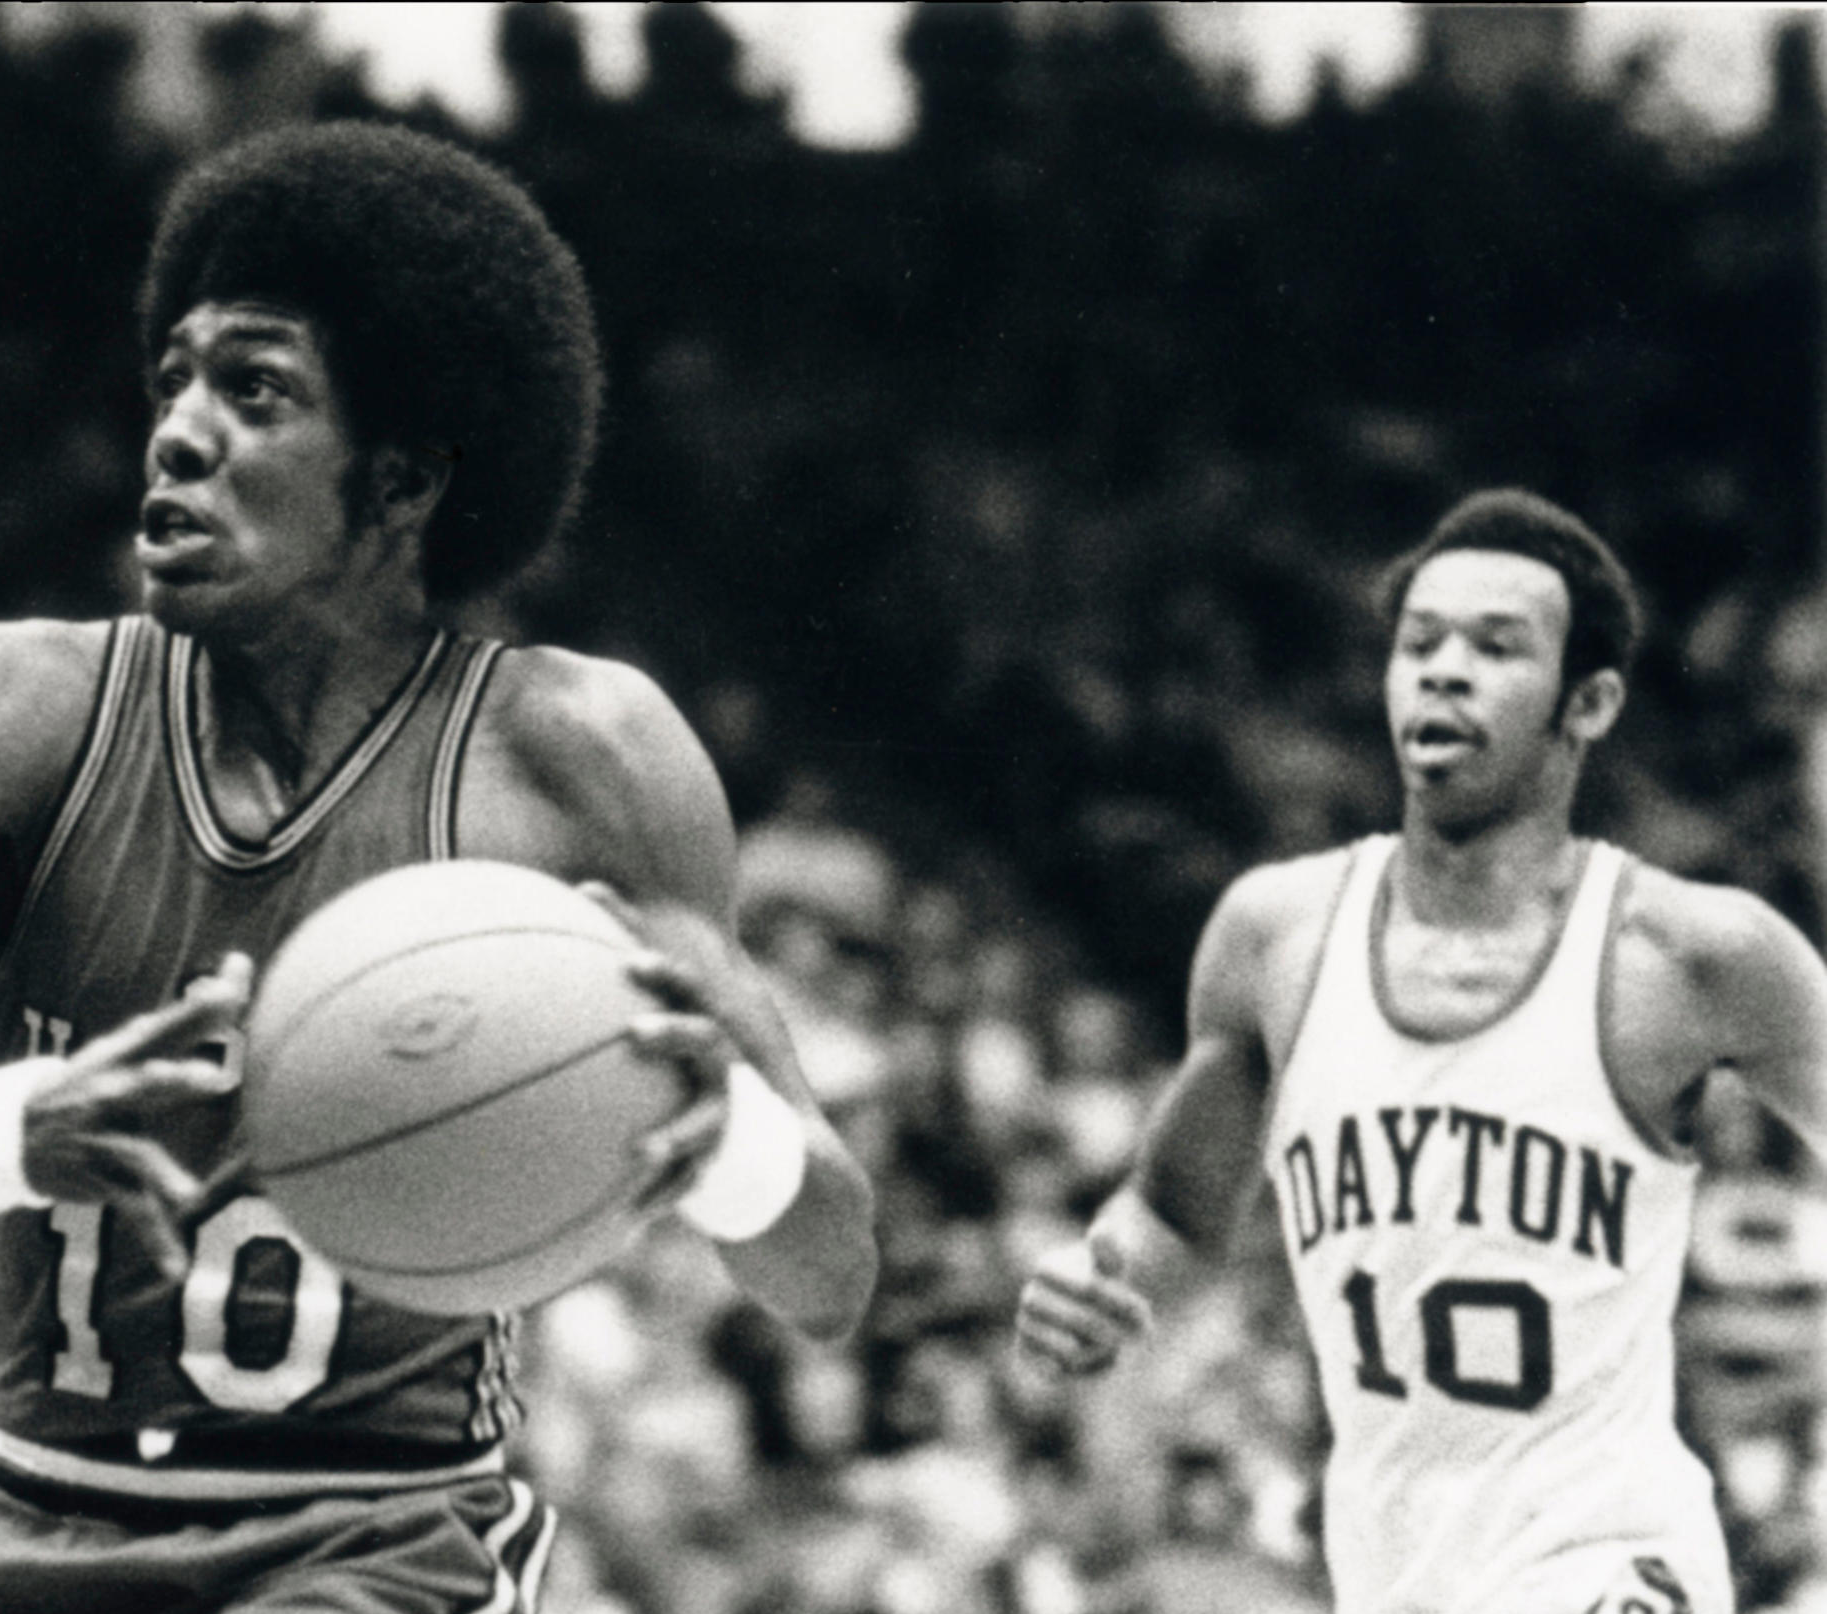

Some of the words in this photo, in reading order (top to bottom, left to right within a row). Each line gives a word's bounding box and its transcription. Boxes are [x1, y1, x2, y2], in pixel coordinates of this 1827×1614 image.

[1283, 1105, 1633, 1268] DAYTON
[49, 1196, 344, 1413] 10
[1341, 1268, 1553, 1412] 10
